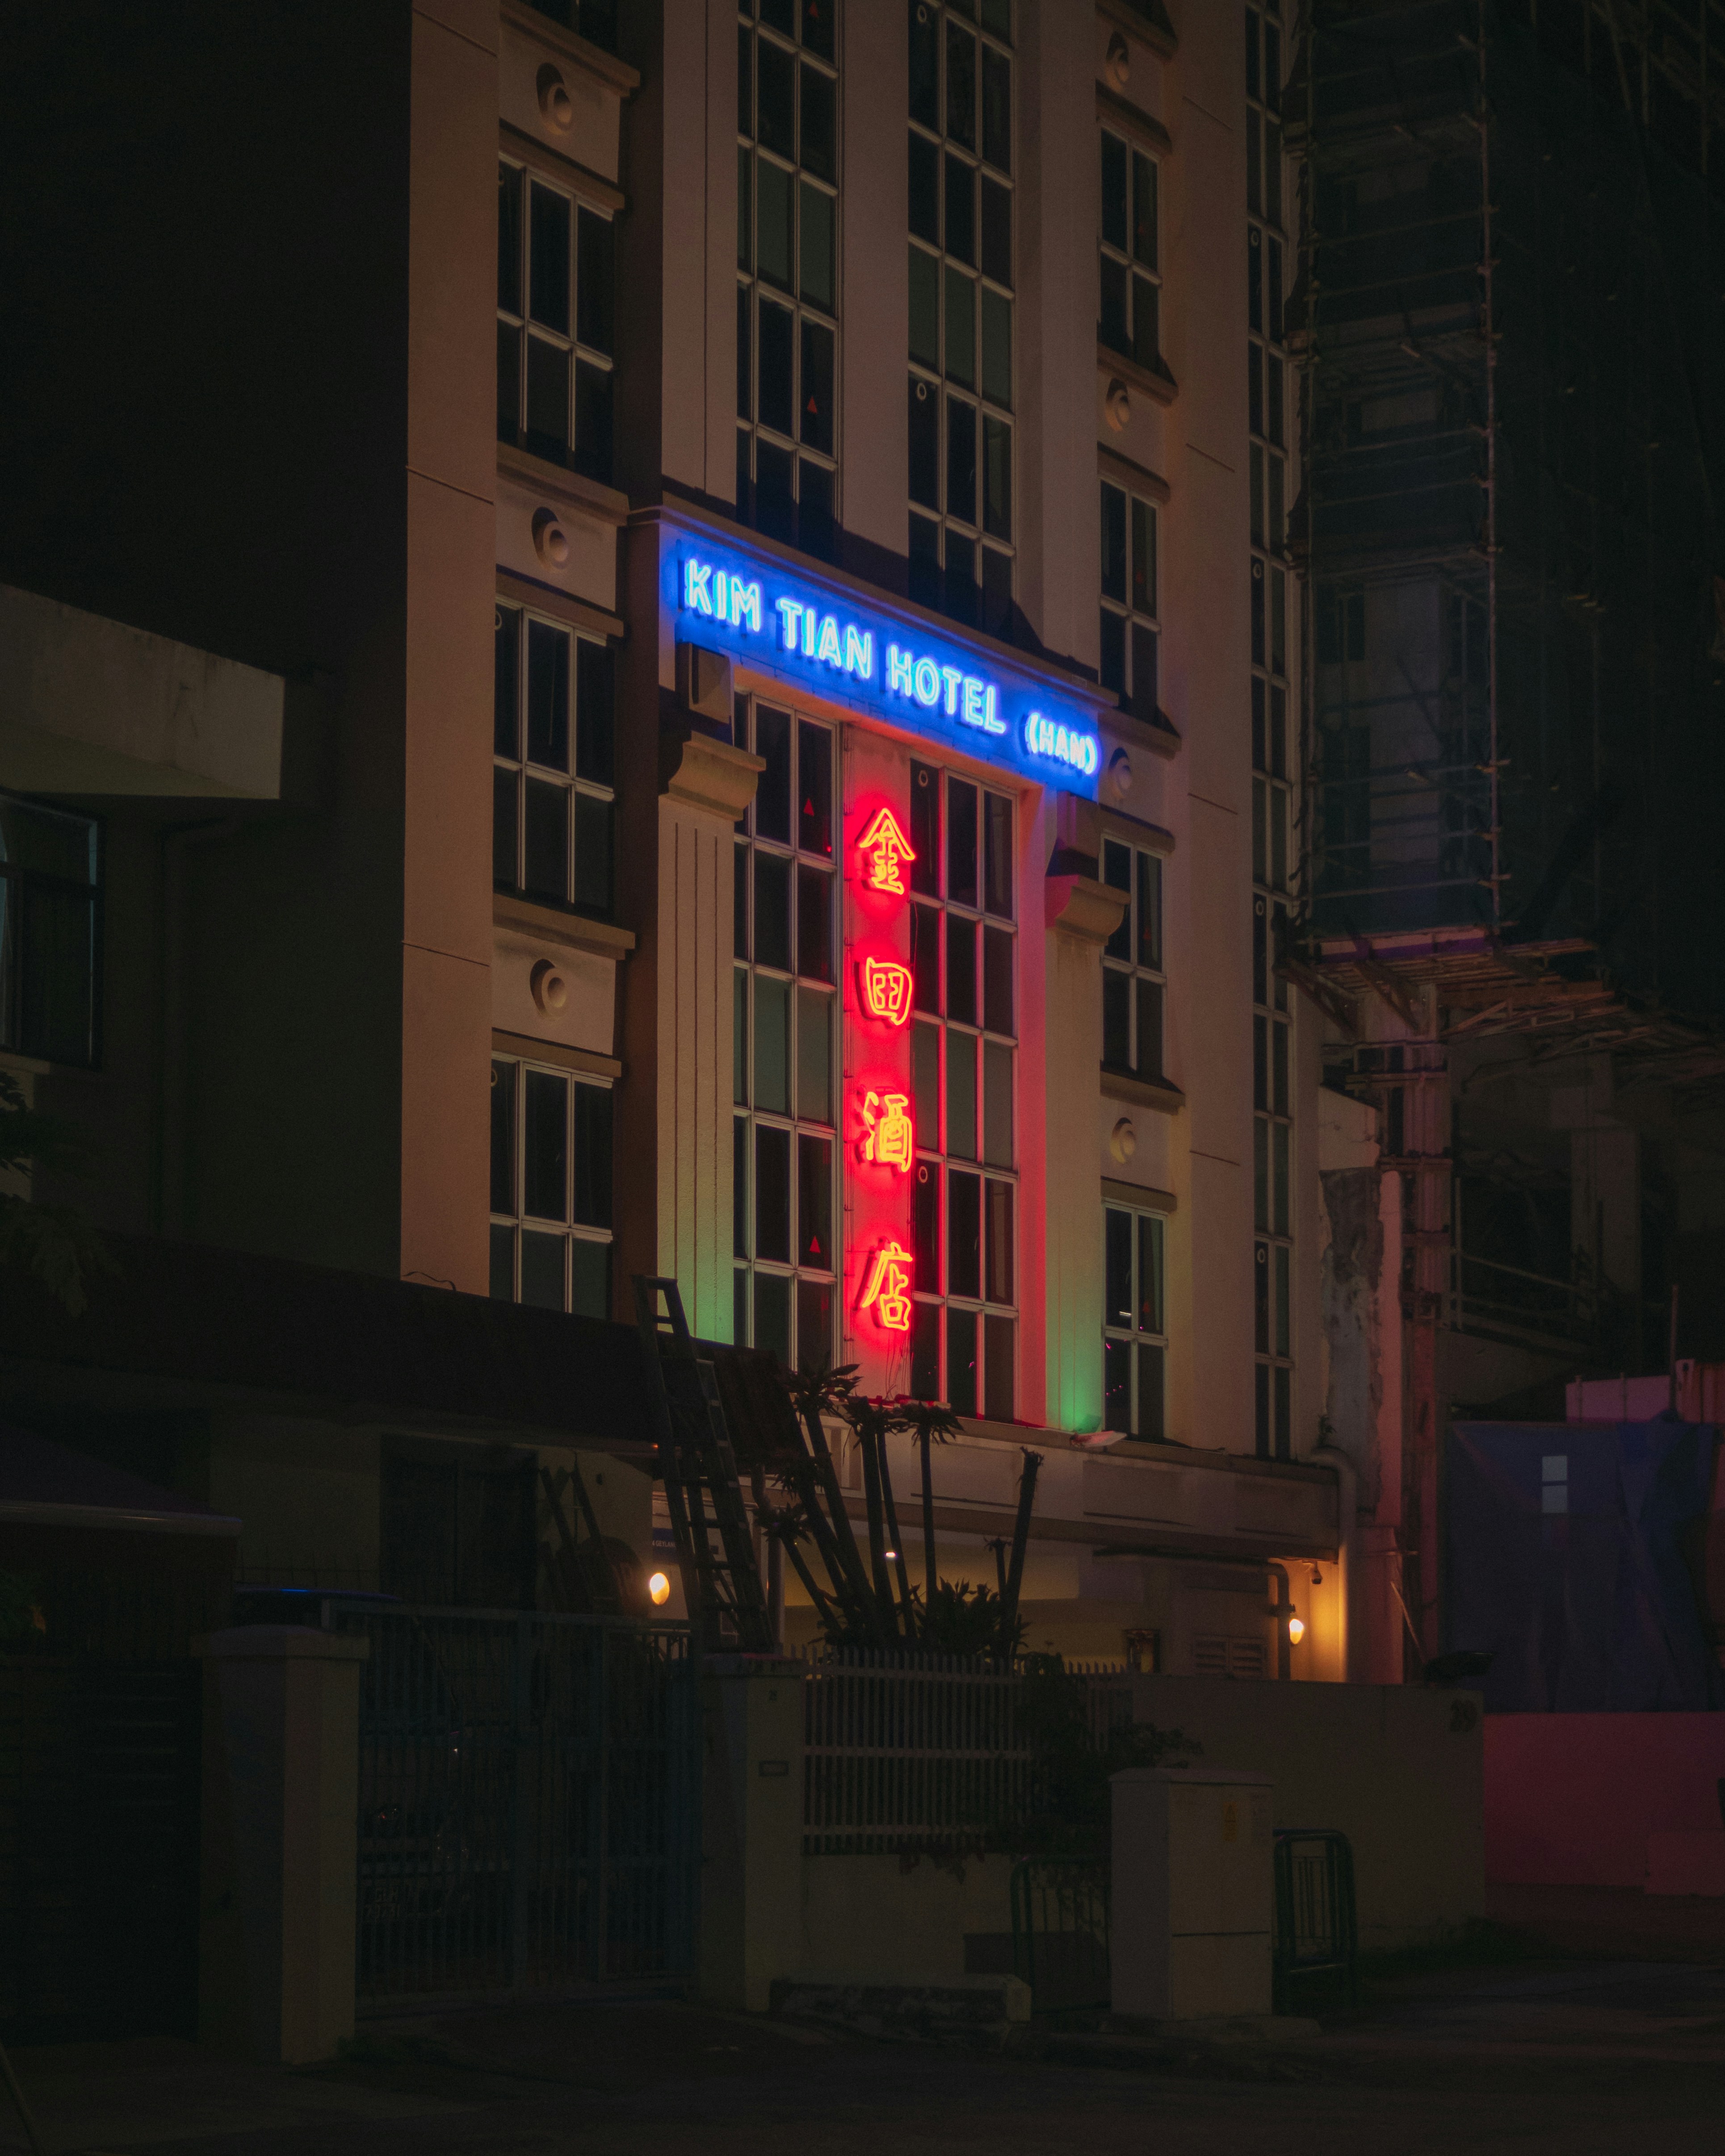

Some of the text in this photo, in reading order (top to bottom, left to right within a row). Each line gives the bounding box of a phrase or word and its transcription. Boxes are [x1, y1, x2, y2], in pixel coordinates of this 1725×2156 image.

[684, 558, 1099, 775] KIM TIAN HOTEL (HAN)
[859, 806, 915, 1333] 金田酒店
